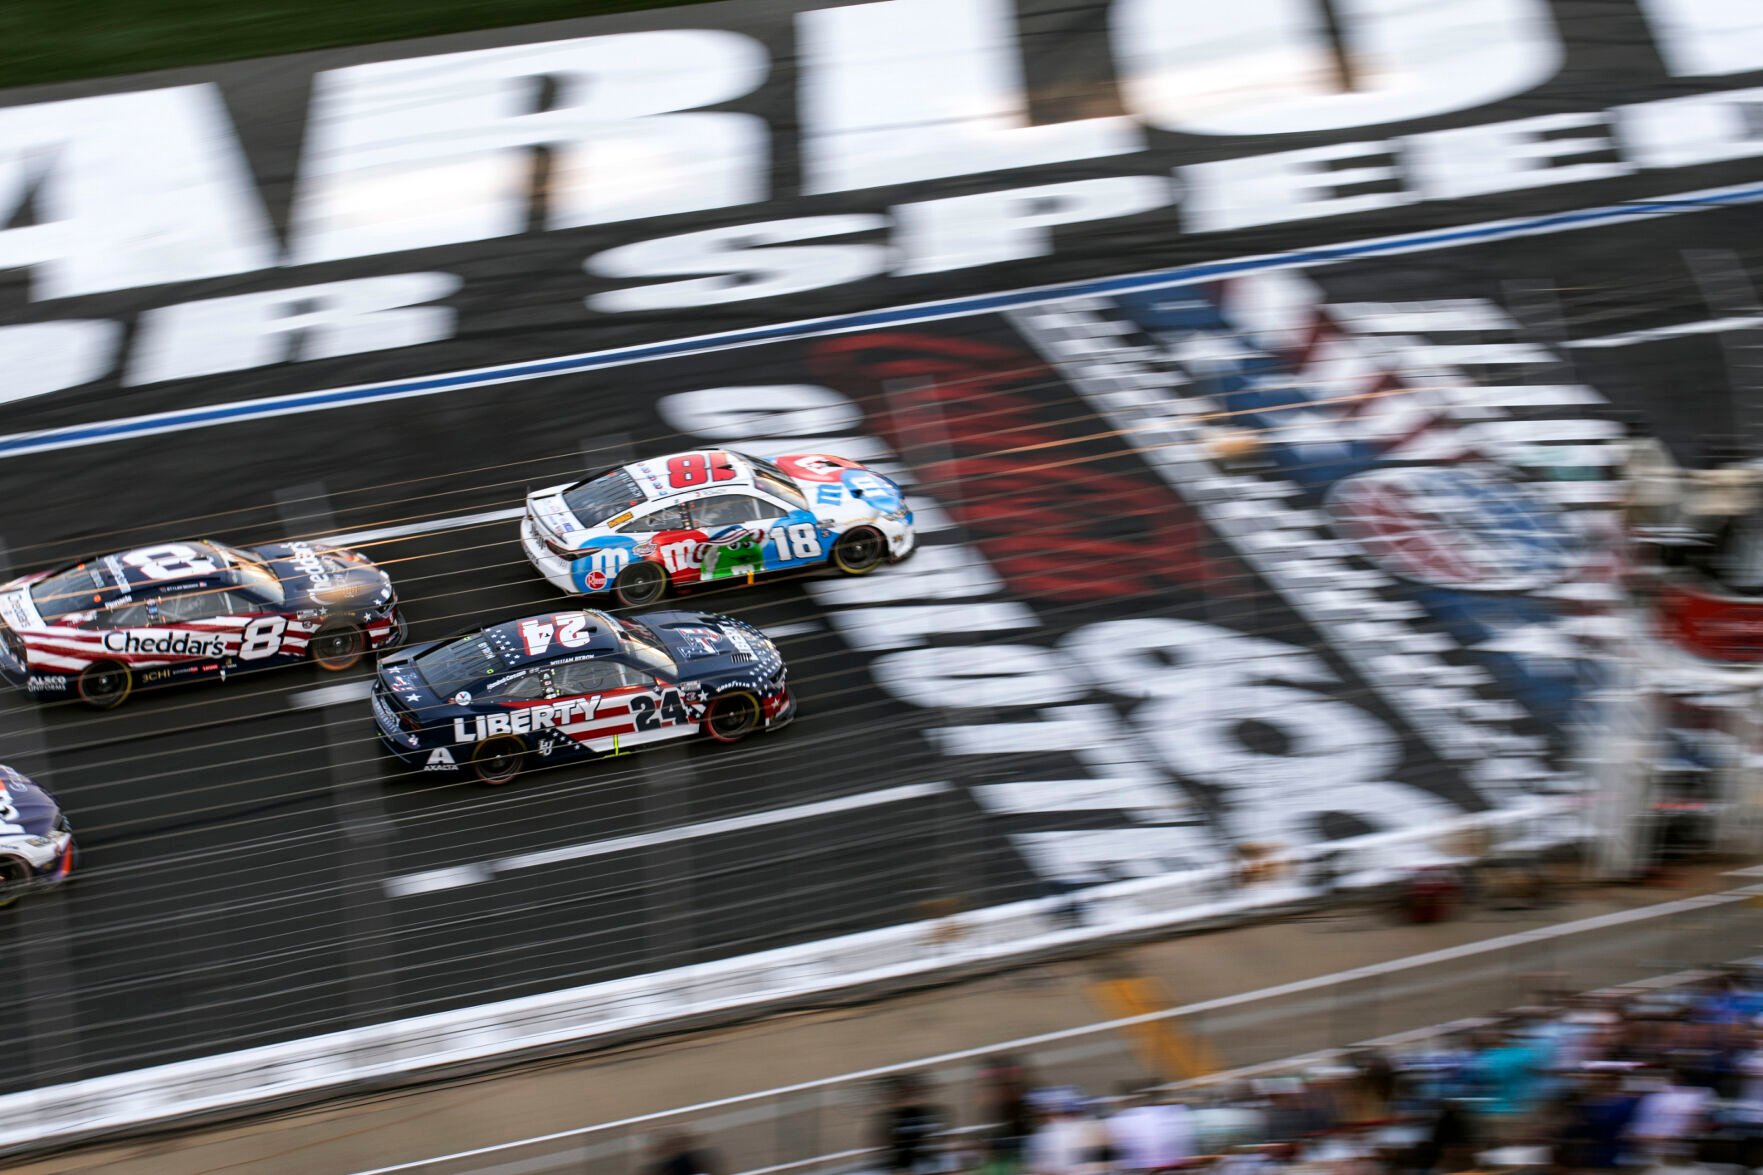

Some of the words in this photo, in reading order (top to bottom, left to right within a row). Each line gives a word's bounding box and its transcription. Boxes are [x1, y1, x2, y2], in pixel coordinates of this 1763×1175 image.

[122, 544, 218, 580] 8
[769, 522, 823, 563] 18
[104, 631, 225, 657] Cheddar's
[238, 615, 288, 661] 8
[517, 613, 591, 657] 24
[453, 694, 602, 743] LIBERTY
[629, 686, 691, 733] 24
